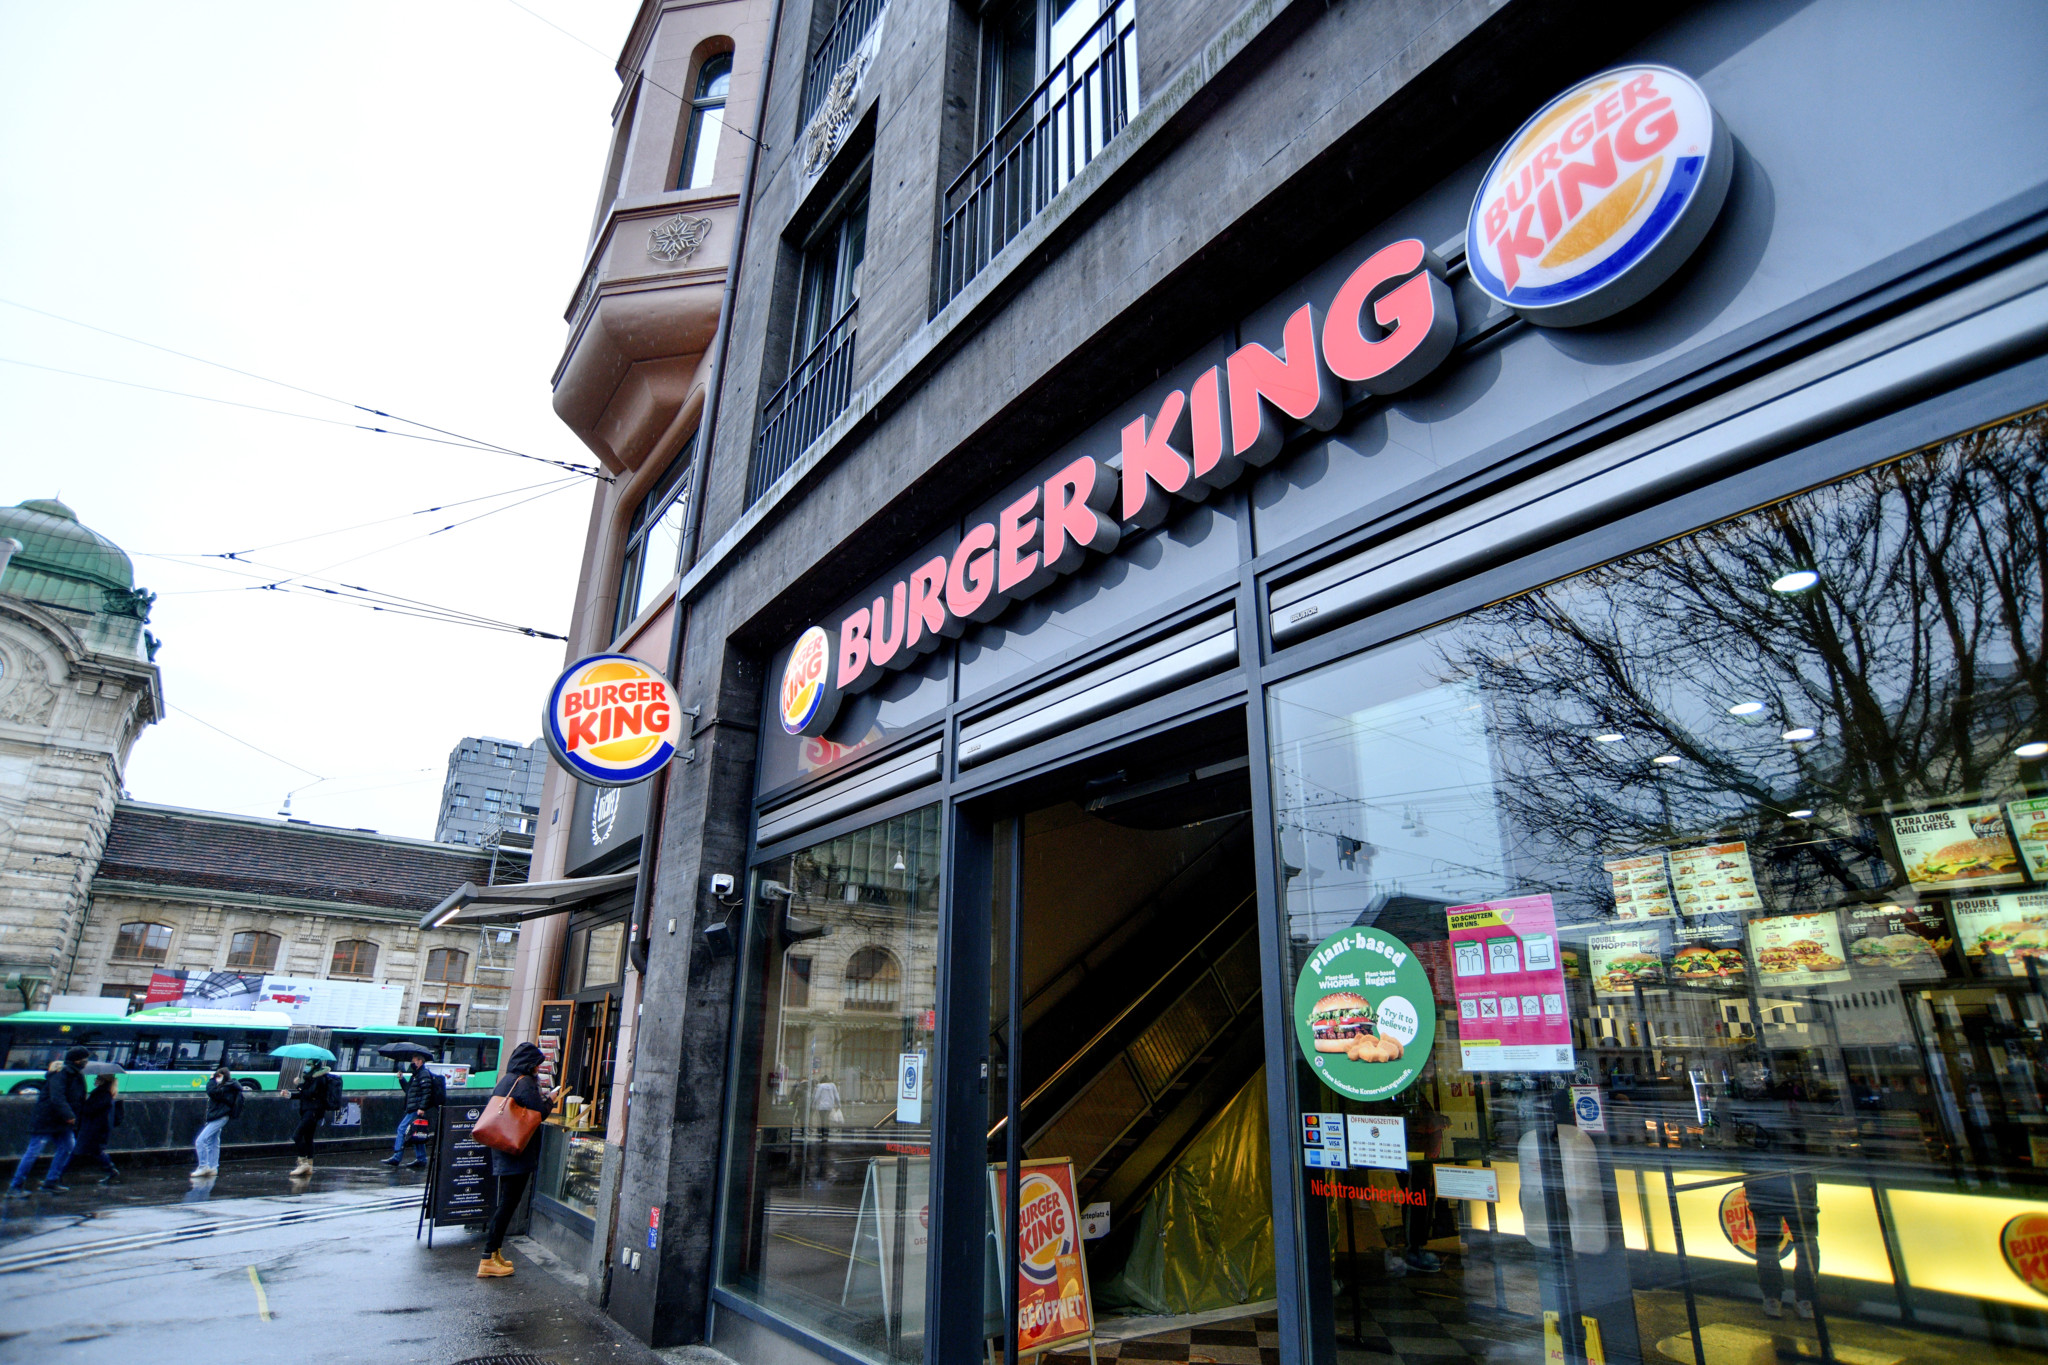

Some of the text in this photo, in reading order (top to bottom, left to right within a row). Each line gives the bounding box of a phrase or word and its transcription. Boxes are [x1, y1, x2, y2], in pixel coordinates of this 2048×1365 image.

[1483, 72, 1660, 247] BURGER
[1495, 96, 1679, 297] KING
[836, 238, 1436, 690] BURGER KING
[564, 681, 666, 718] BURGER
[566, 701, 670, 753] KING
[1895, 812, 1950, 827] X-TRA LONG
[1896, 819, 1957, 835] CHILI CHEESE
[1956, 899, 1999, 909] DOUBLE
[1957, 905, 2000, 915] STEAKHOUSE
[1460, 911, 1493, 921] SCHÜTZEN
[1464, 920, 1480, 928] UNS.
[1674, 923, 1734, 935] Swiss Selection
[1591, 935, 1616, 943] DOUBLE
[1309, 932, 1407, 975] Plant-based
[1318, 978, 1360, 989] WHOPPER
[1325, 973, 1354, 981] Plant-based
[1365, 975, 1397, 987] Nuggets
[1384, 1007, 1414, 1024] Try it to
[1380, 1017, 1414, 1035] believe it
[1322, 1068, 1335, 1082] Ohne
[1334, 1078, 1360, 1094] künstliche
[1350, 1115, 1399, 1125] ÖFFNUNGSZEITEN
[1310, 1179, 1427, 1207] Nichtraucherlokal
[1080, 1210, 1105, 1220] arteplatz
[1019, 1208, 1066, 1262] KING
[1019, 1293, 1082, 1330] GEÖFFNET
